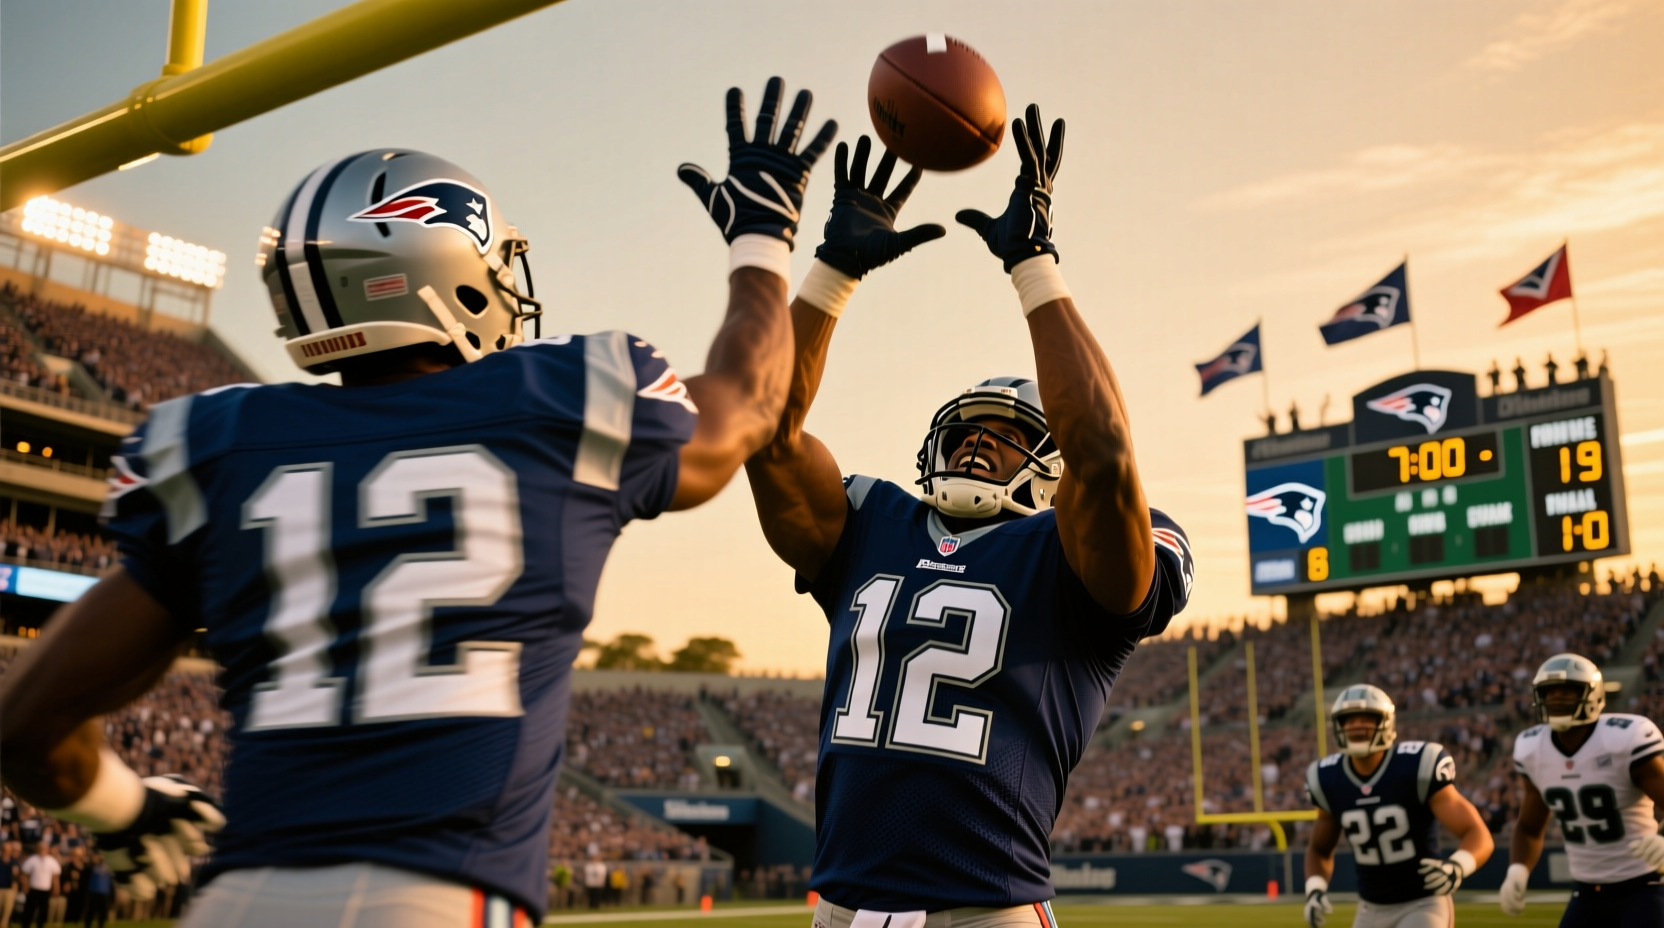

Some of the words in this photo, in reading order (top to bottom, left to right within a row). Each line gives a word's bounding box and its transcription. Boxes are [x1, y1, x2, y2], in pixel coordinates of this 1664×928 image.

[1388, 437, 1466, 483] 7:00
[1560, 440, 1603, 484] 19
[240, 444, 526, 731] 12
[831, 573, 1012, 765] 12
[1341, 804, 1417, 866] 22
[1545, 784, 1625, 844] 29
